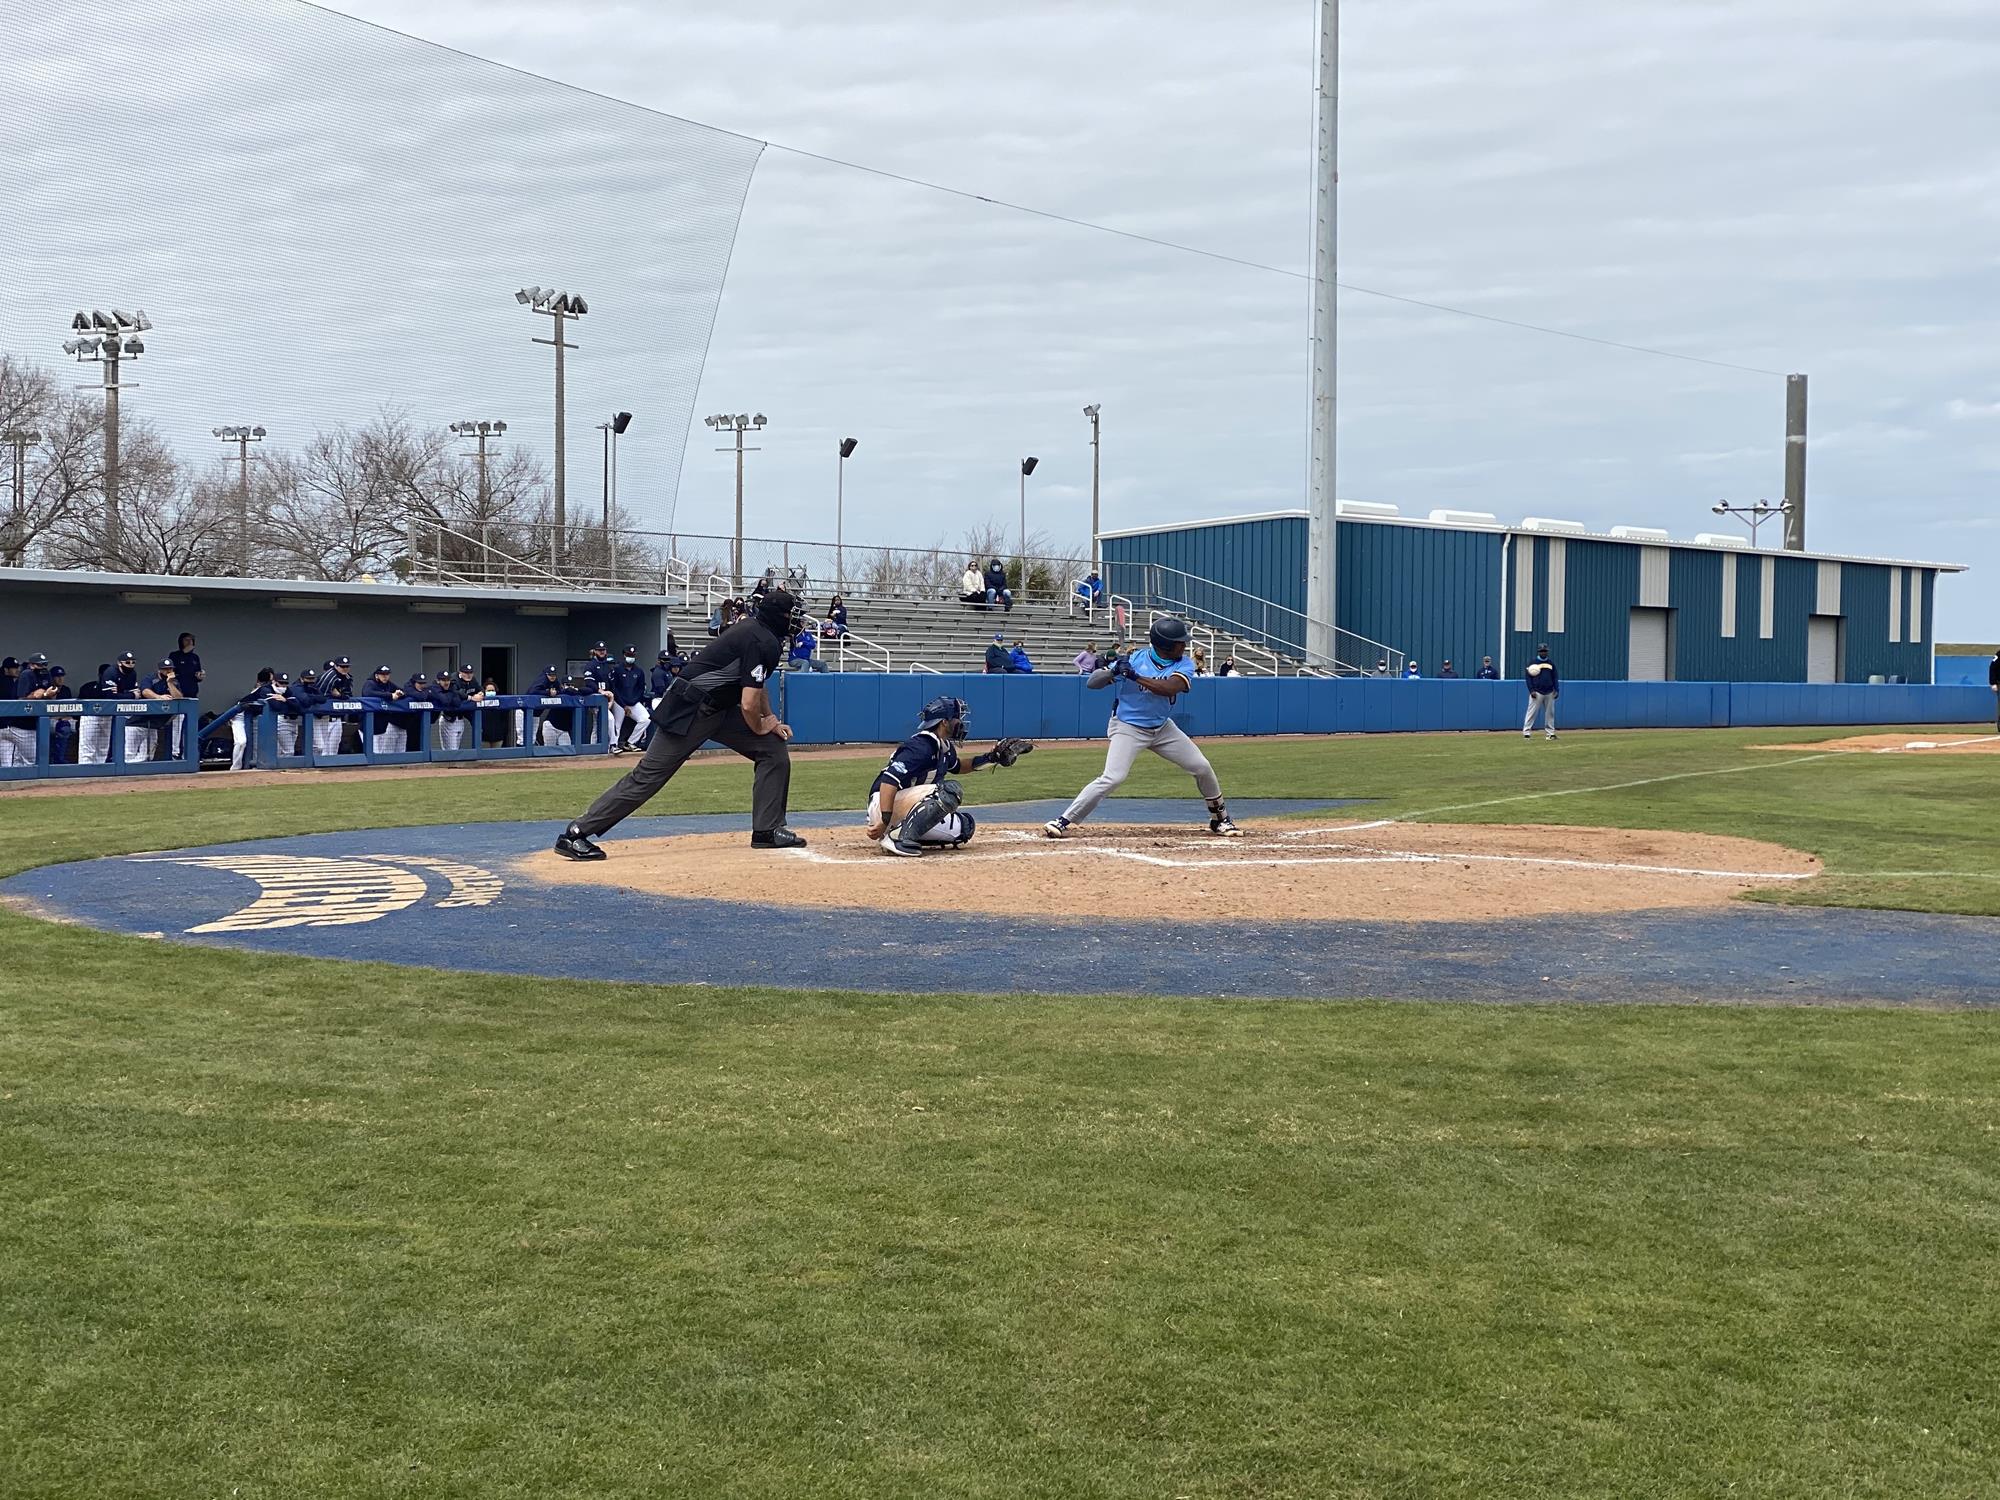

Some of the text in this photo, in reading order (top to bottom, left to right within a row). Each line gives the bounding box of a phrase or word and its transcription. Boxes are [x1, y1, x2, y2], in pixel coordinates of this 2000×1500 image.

[46, 704, 83, 712] NEW ORLEANS
[117, 704, 147, 712] PRIVATEERS
